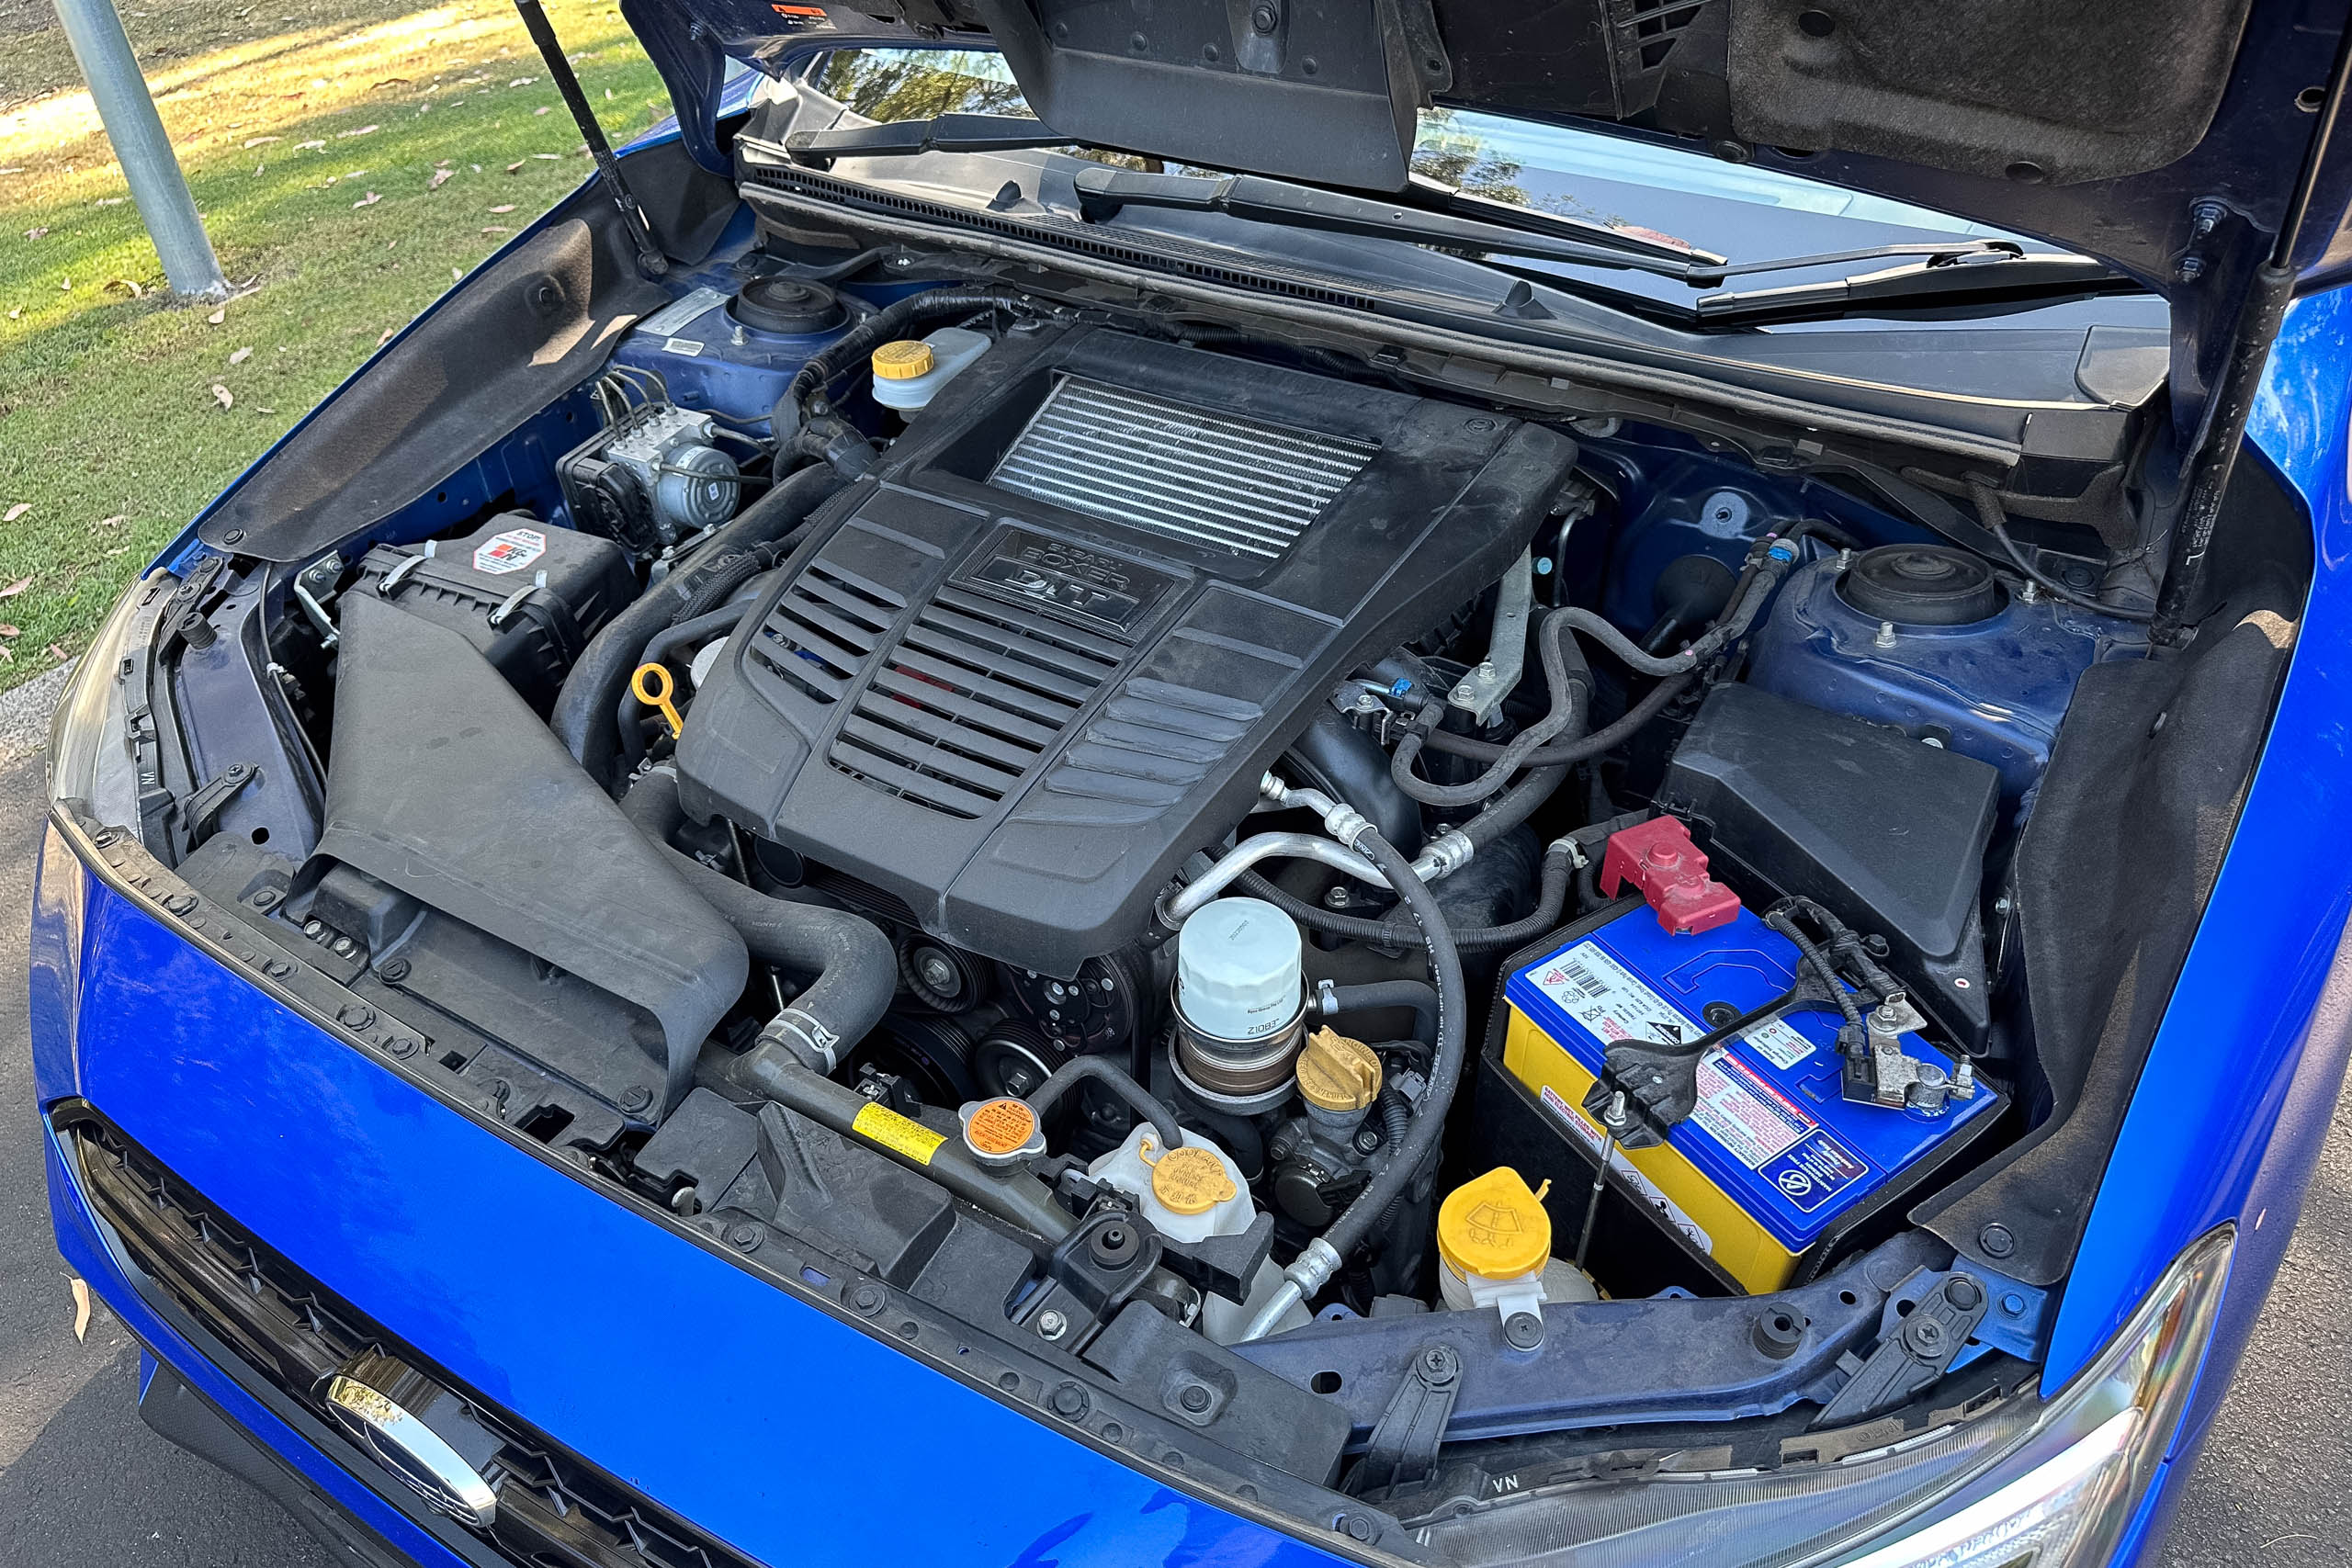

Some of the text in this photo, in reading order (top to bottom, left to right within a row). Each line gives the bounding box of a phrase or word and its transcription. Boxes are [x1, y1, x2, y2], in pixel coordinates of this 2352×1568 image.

[1022, 546, 1131, 592] BOXER
[140, 771, 155, 785] VN
[1595, 1004, 1607, 1013] Pb
[1654, 1023, 1681, 1044] CORROSIVE
[1168, 1148, 1223, 1177] COOLANT
[1785, 1153, 1832, 1191] MAINTENANCE FREE
[1804, 1161, 1823, 1177] DESIGN
[1492, 1473, 1519, 1494] VN
